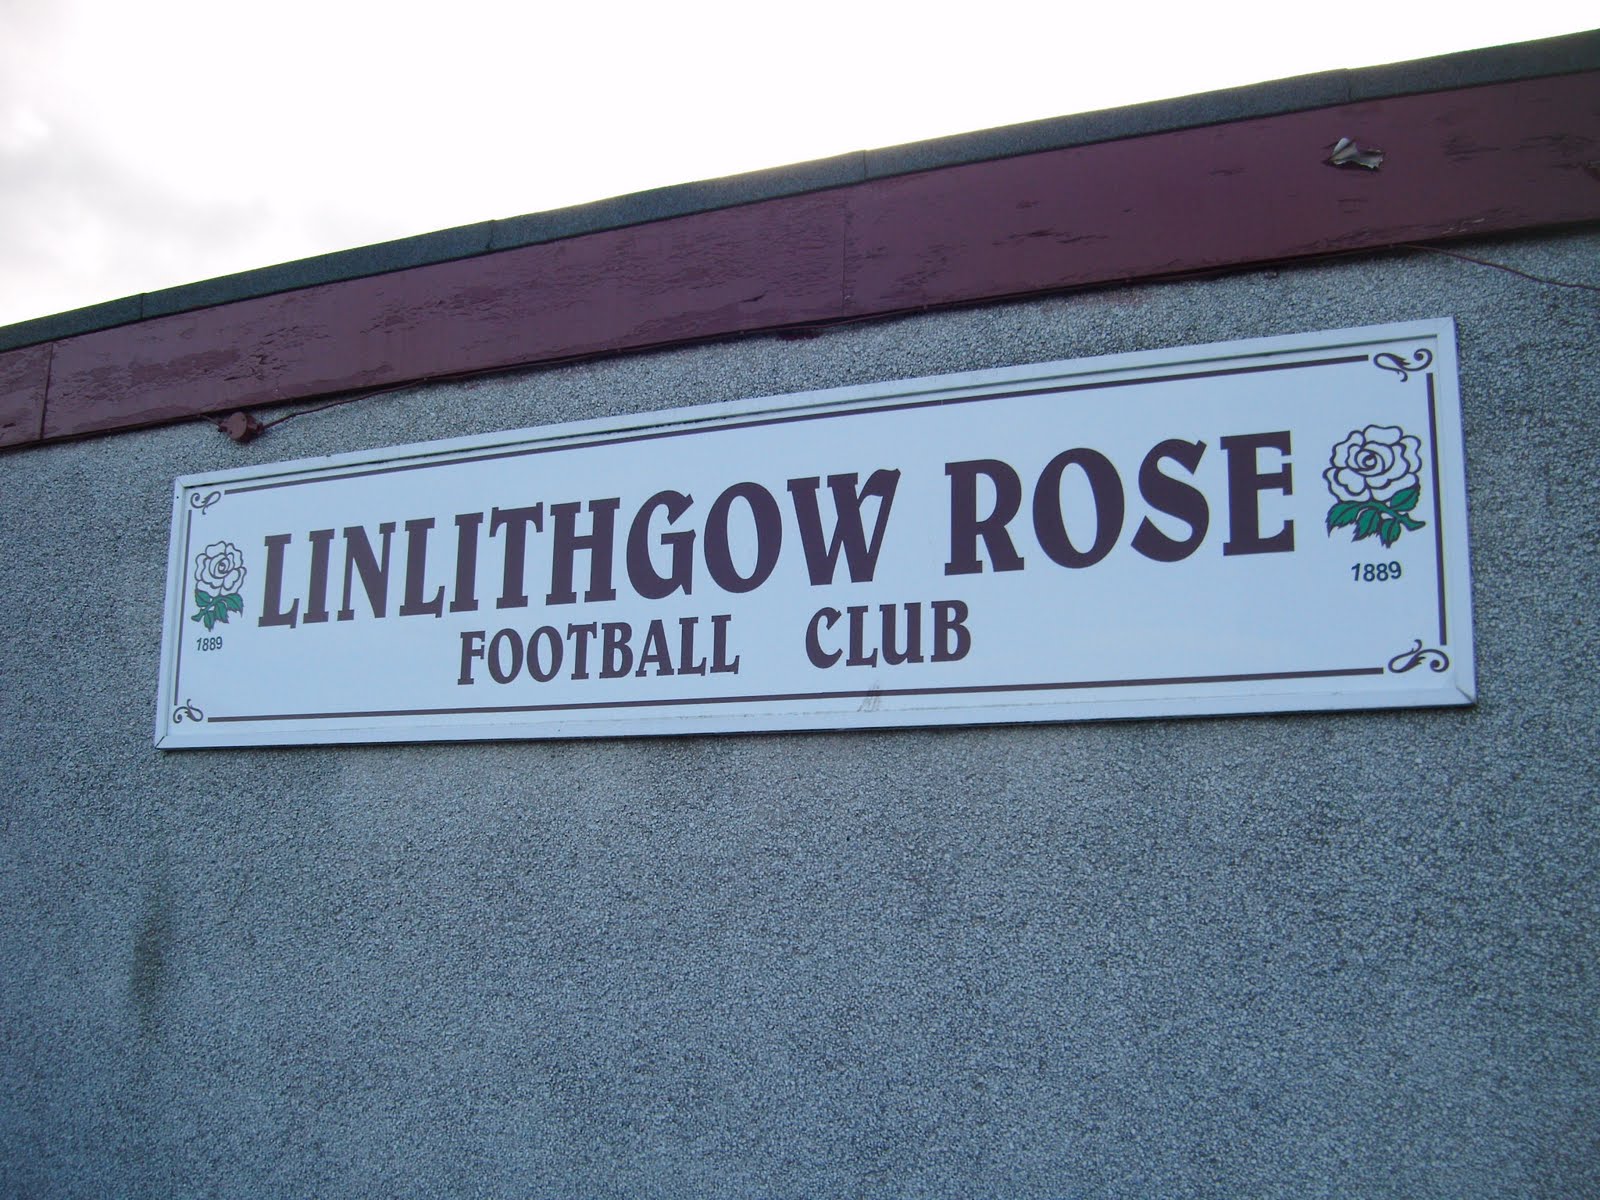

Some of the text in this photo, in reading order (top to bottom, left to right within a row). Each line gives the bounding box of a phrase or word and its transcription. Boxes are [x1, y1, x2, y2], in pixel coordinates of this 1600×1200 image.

[258, 429, 1295, 629] LINLITHGOW ROSE
[1351, 560, 1402, 583] 1889
[195, 635, 223, 652] 1889
[457, 599, 972, 686] FOOTBALL CLUB
